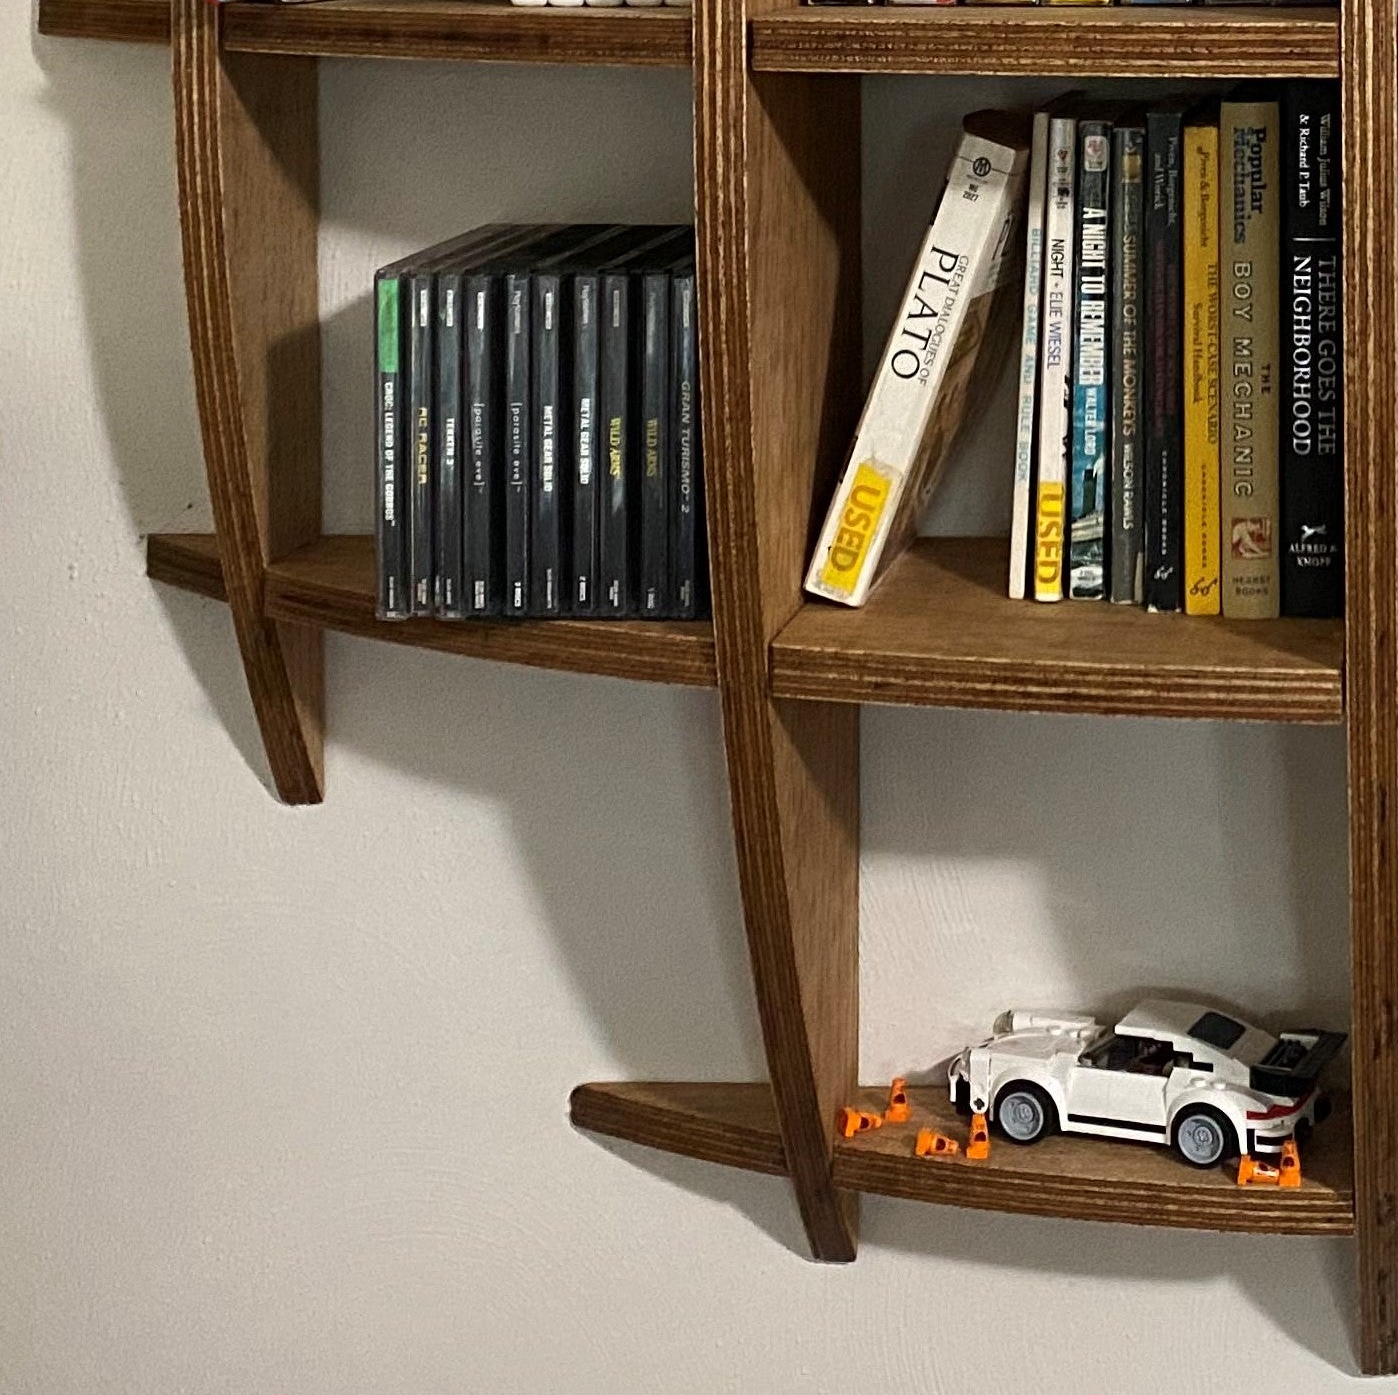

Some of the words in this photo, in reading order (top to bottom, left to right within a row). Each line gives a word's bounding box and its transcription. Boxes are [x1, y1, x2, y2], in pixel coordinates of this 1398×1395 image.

[1299, 128, 1311, 165] Richard
[1233, 127, 1252, 244] Mechanics
[1247, 127, 1267, 214] Popular
[1083, 207, 1108, 219] A
[1050, 239, 1066, 278] NIGHT
[1082, 223, 1107, 268] NIGHT
[1122, 235, 1136, 299] SUMMER
[1208, 263, 1219, 287] THE
[1233, 260, 1252, 320] BOY
[1318, 256, 1336, 335] THERE
[891, 245, 960, 381] PLATO
[1048, 292, 1062, 317] ELIE
[1122, 305, 1136, 327] OF
[1046, 321, 1061, 370] WIESEL
[1080, 299, 1106, 385] REMEMBER
[1122, 331, 1136, 355] THE
[1207, 291, 1219, 373] WORST-CASE
[1023, 356, 1036, 384] AND
[1292, 255, 1312, 455] NEIGHBORHOOD
[1318, 339, 1336, 401] GOES
[1122, 358, 1136, 436] MONKEYS
[1261, 364, 1271, 394] THE
[543, 406, 554, 436] METAL
[579, 398, 590, 429] METAL
[681, 381, 691, 424] GRAN
[1207, 378, 1219, 445] SCENARIO
[1232, 337, 1252, 497] MECHANIC
[446, 418, 456, 455] TEKKEN
[543, 439, 554, 463] GEAR
[579, 432, 590, 456] GEAR
[609, 418, 621, 447] WILD
[645, 418, 657, 447] WILD
[1318, 407, 1336, 454] THE
[543, 465, 554, 491] SOLID
[579, 458, 590, 483] SOLID
[681, 428, 691, 490] TURISMO
[1016, 441, 1030, 481] BOOK
[829, 483, 882, 572] USED
[1036, 491, 1064, 584] USED
